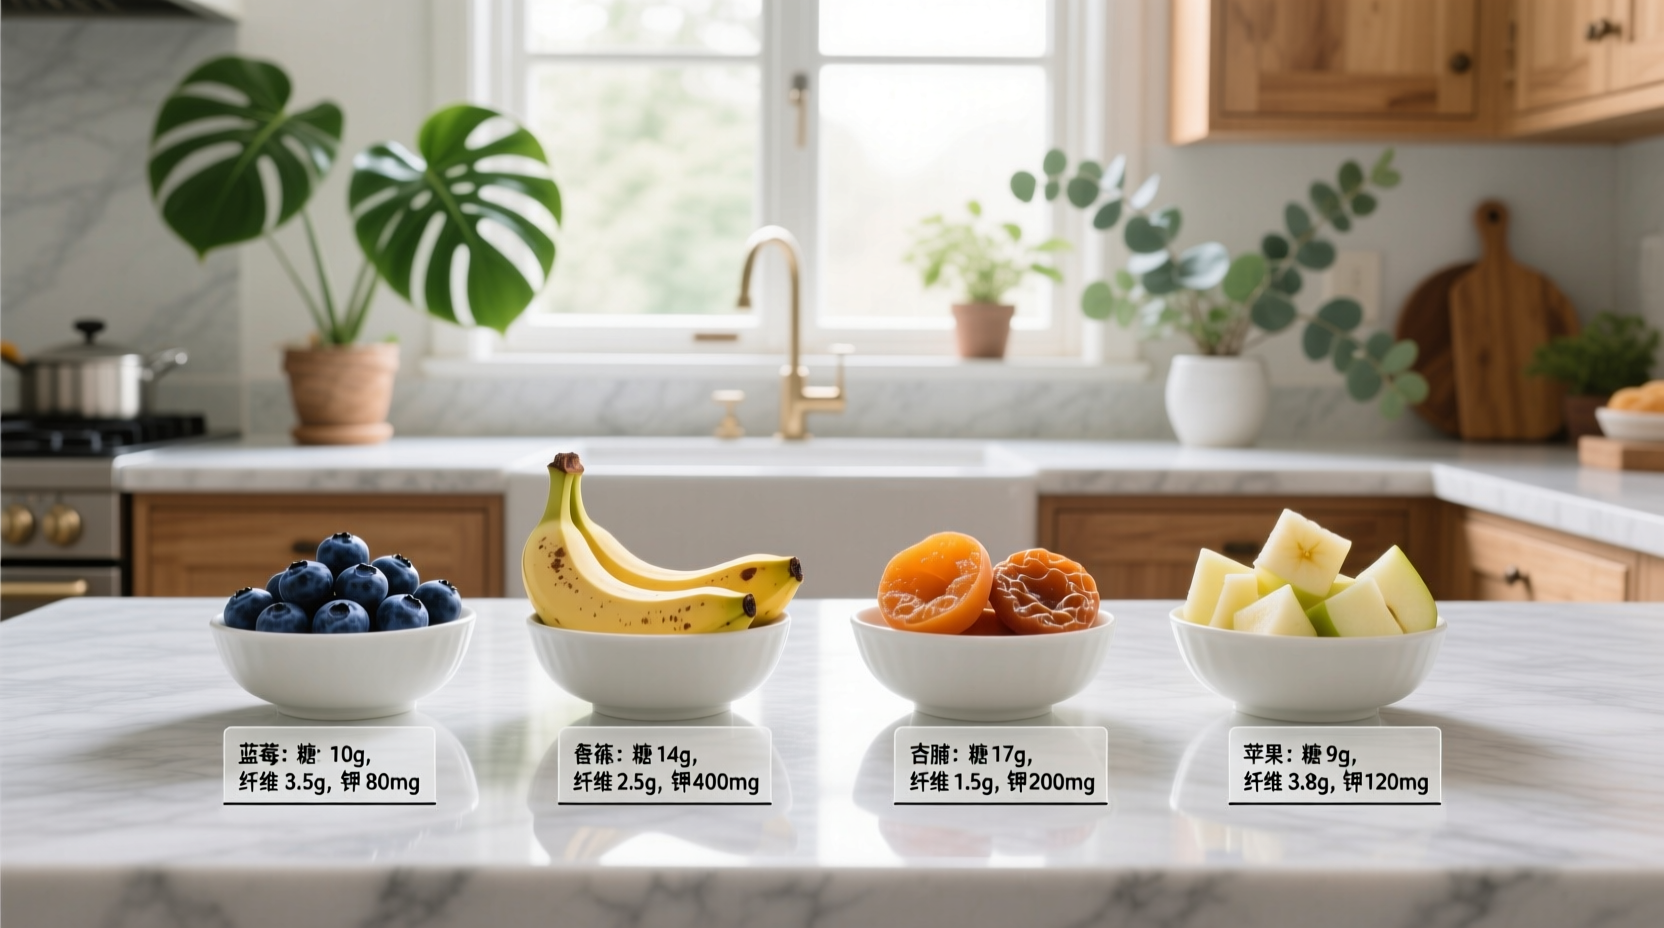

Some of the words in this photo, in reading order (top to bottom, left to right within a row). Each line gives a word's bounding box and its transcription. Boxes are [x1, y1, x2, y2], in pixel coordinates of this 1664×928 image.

[330, 745, 371, 768] 10g,
[1326, 744, 1357, 768] 9g,
[238, 770, 279, 793] 纤维
[285, 772, 332, 796] 3.5g,
[366, 772, 420, 796] 80mg
[572, 770, 613, 793] 纤维
[617, 772, 663, 796] 2.5g,
[909, 770, 950, 793] 纤维
[954, 772, 1000, 796] 1.5g,
[1243, 770, 1283, 793] 纤维
[1288, 772, 1335, 796] 3.8g,
